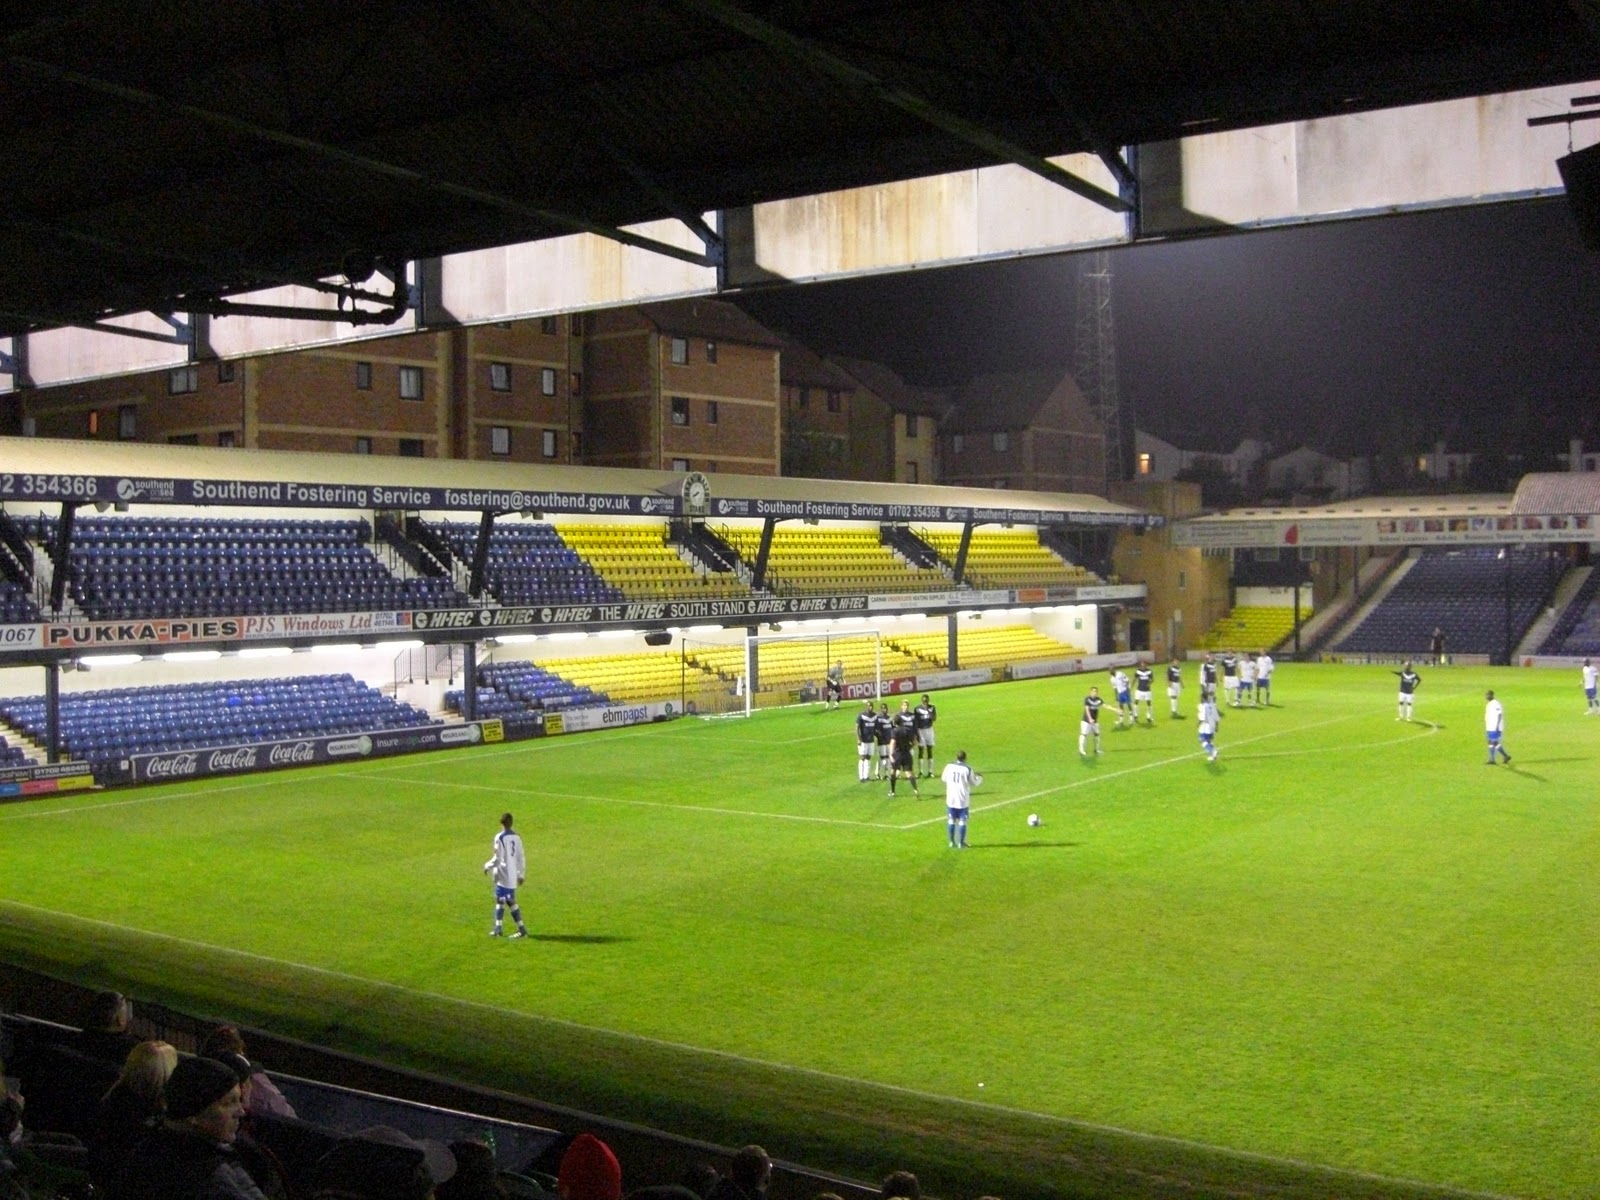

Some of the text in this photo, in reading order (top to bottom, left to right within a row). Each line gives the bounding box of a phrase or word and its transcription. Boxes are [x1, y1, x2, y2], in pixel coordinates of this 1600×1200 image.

[0, 474, 97, 496] 2 354366
[135, 480, 175, 489] southend
[192, 480, 431, 507] Southend Fostering Service
[444, 489, 630, 512] fostering@southend.gov.uk
[756, 500, 803, 514] Southend
[806, 502, 849, 518] Fostering
[851, 504, 883, 516] Service
[888, 506, 911, 517] 01702
[912, 506, 941, 518] 354366
[973, 508, 1007, 519] Southend
[1008, 509, 1039, 522] Fostering
[599, 600, 745, 620] THE HI-TEC SOUTH STAND
[756, 599, 786, 613] HI-TEC
[800, 598, 827, 611] HI-TEC
[838, 597, 865, 609] HI-TEC
[245, 613, 373, 633] PJS Windows Ltd
[430, 610, 474, 628] HI-TEC
[494, 608, 535, 625] HI-TEC
[554, 607, 592, 622] HI-TEC
[50, 621, 239, 644] PUKKA-PIES
[602, 705, 647, 725] ebmpapst
[208, 747, 257, 771] Coca-Cola
[269, 741, 315, 763] Coca-Cola
[146, 753, 198, 777] Coca-Cola
[953, 771, 960, 783] 11
